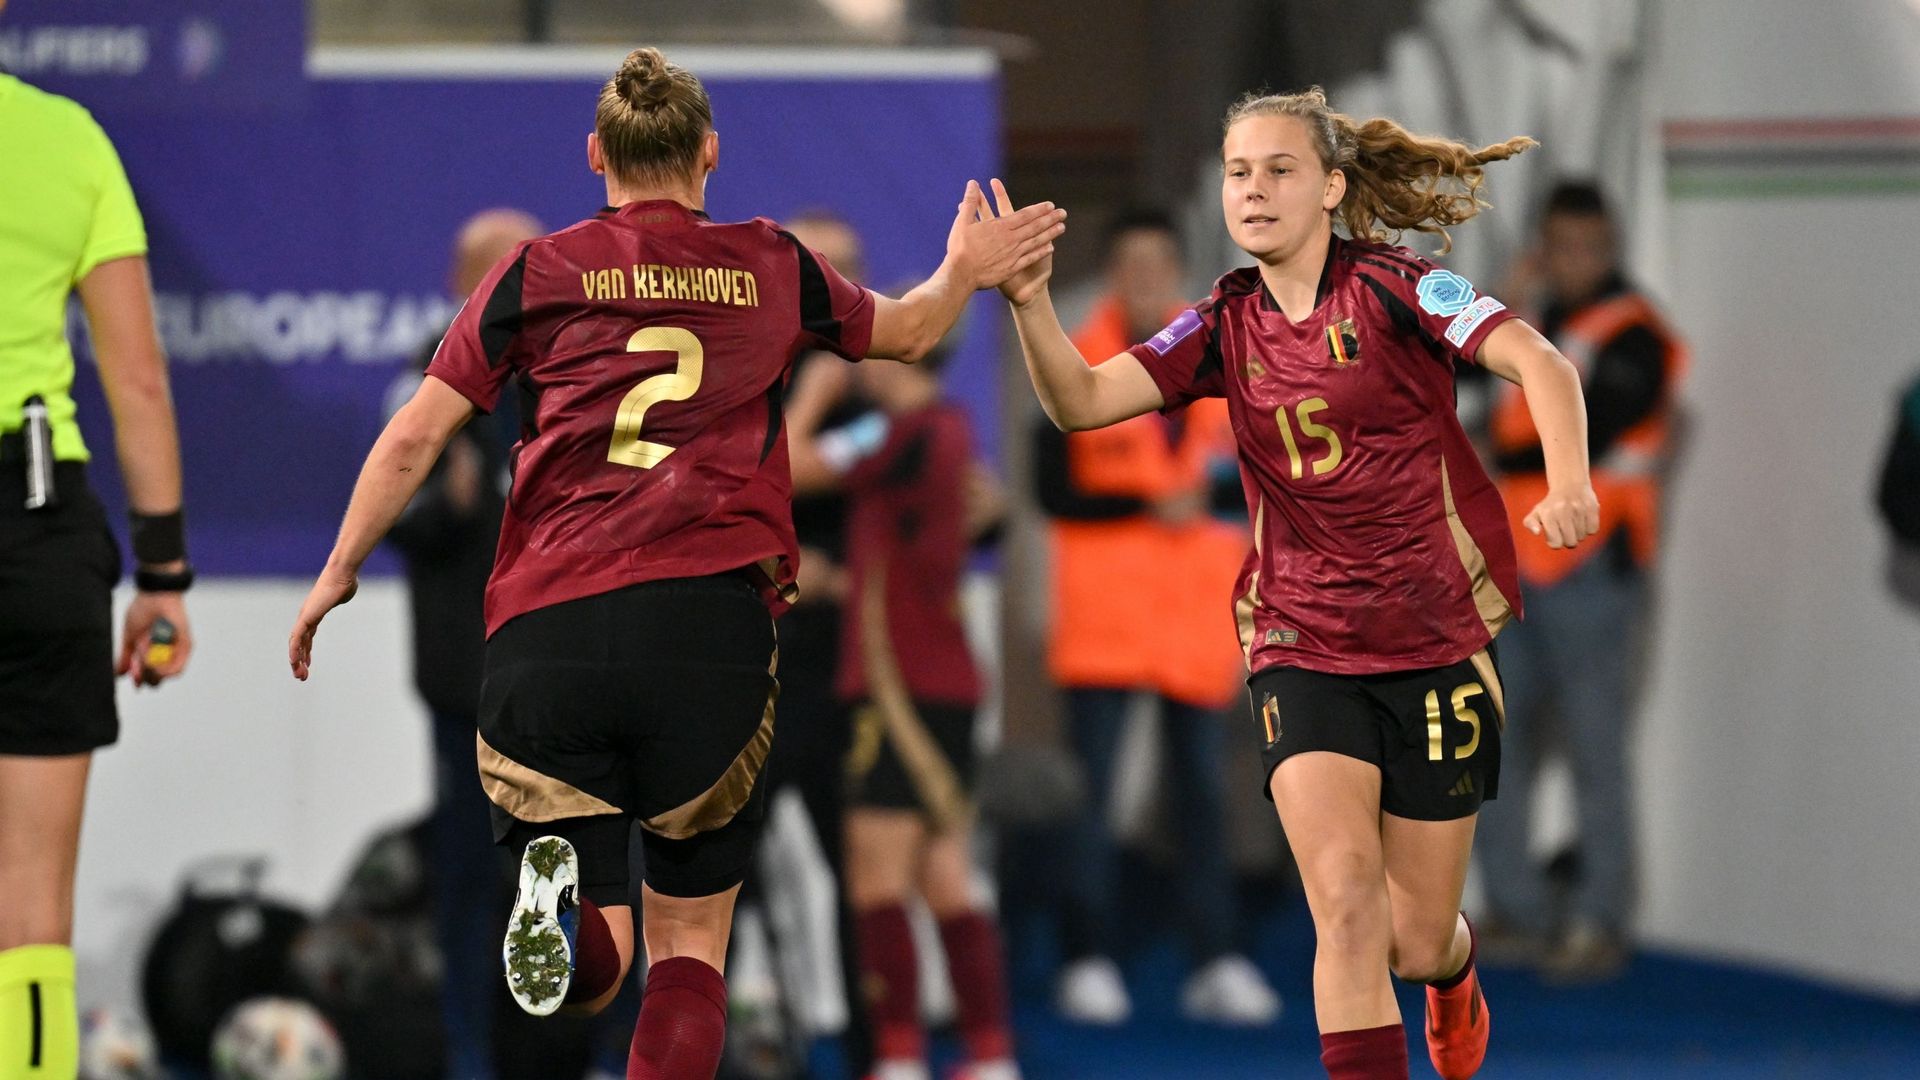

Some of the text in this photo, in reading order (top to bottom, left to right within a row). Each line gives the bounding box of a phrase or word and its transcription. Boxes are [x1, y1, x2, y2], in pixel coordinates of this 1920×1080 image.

[582, 264, 759, 307] VAN KERKHOVEN
[1450, 301, 1495, 342] FOUNDATIO
[607, 326, 704, 470] 2
[1275, 397, 1343, 480] 15
[1424, 682, 1484, 761] 15
